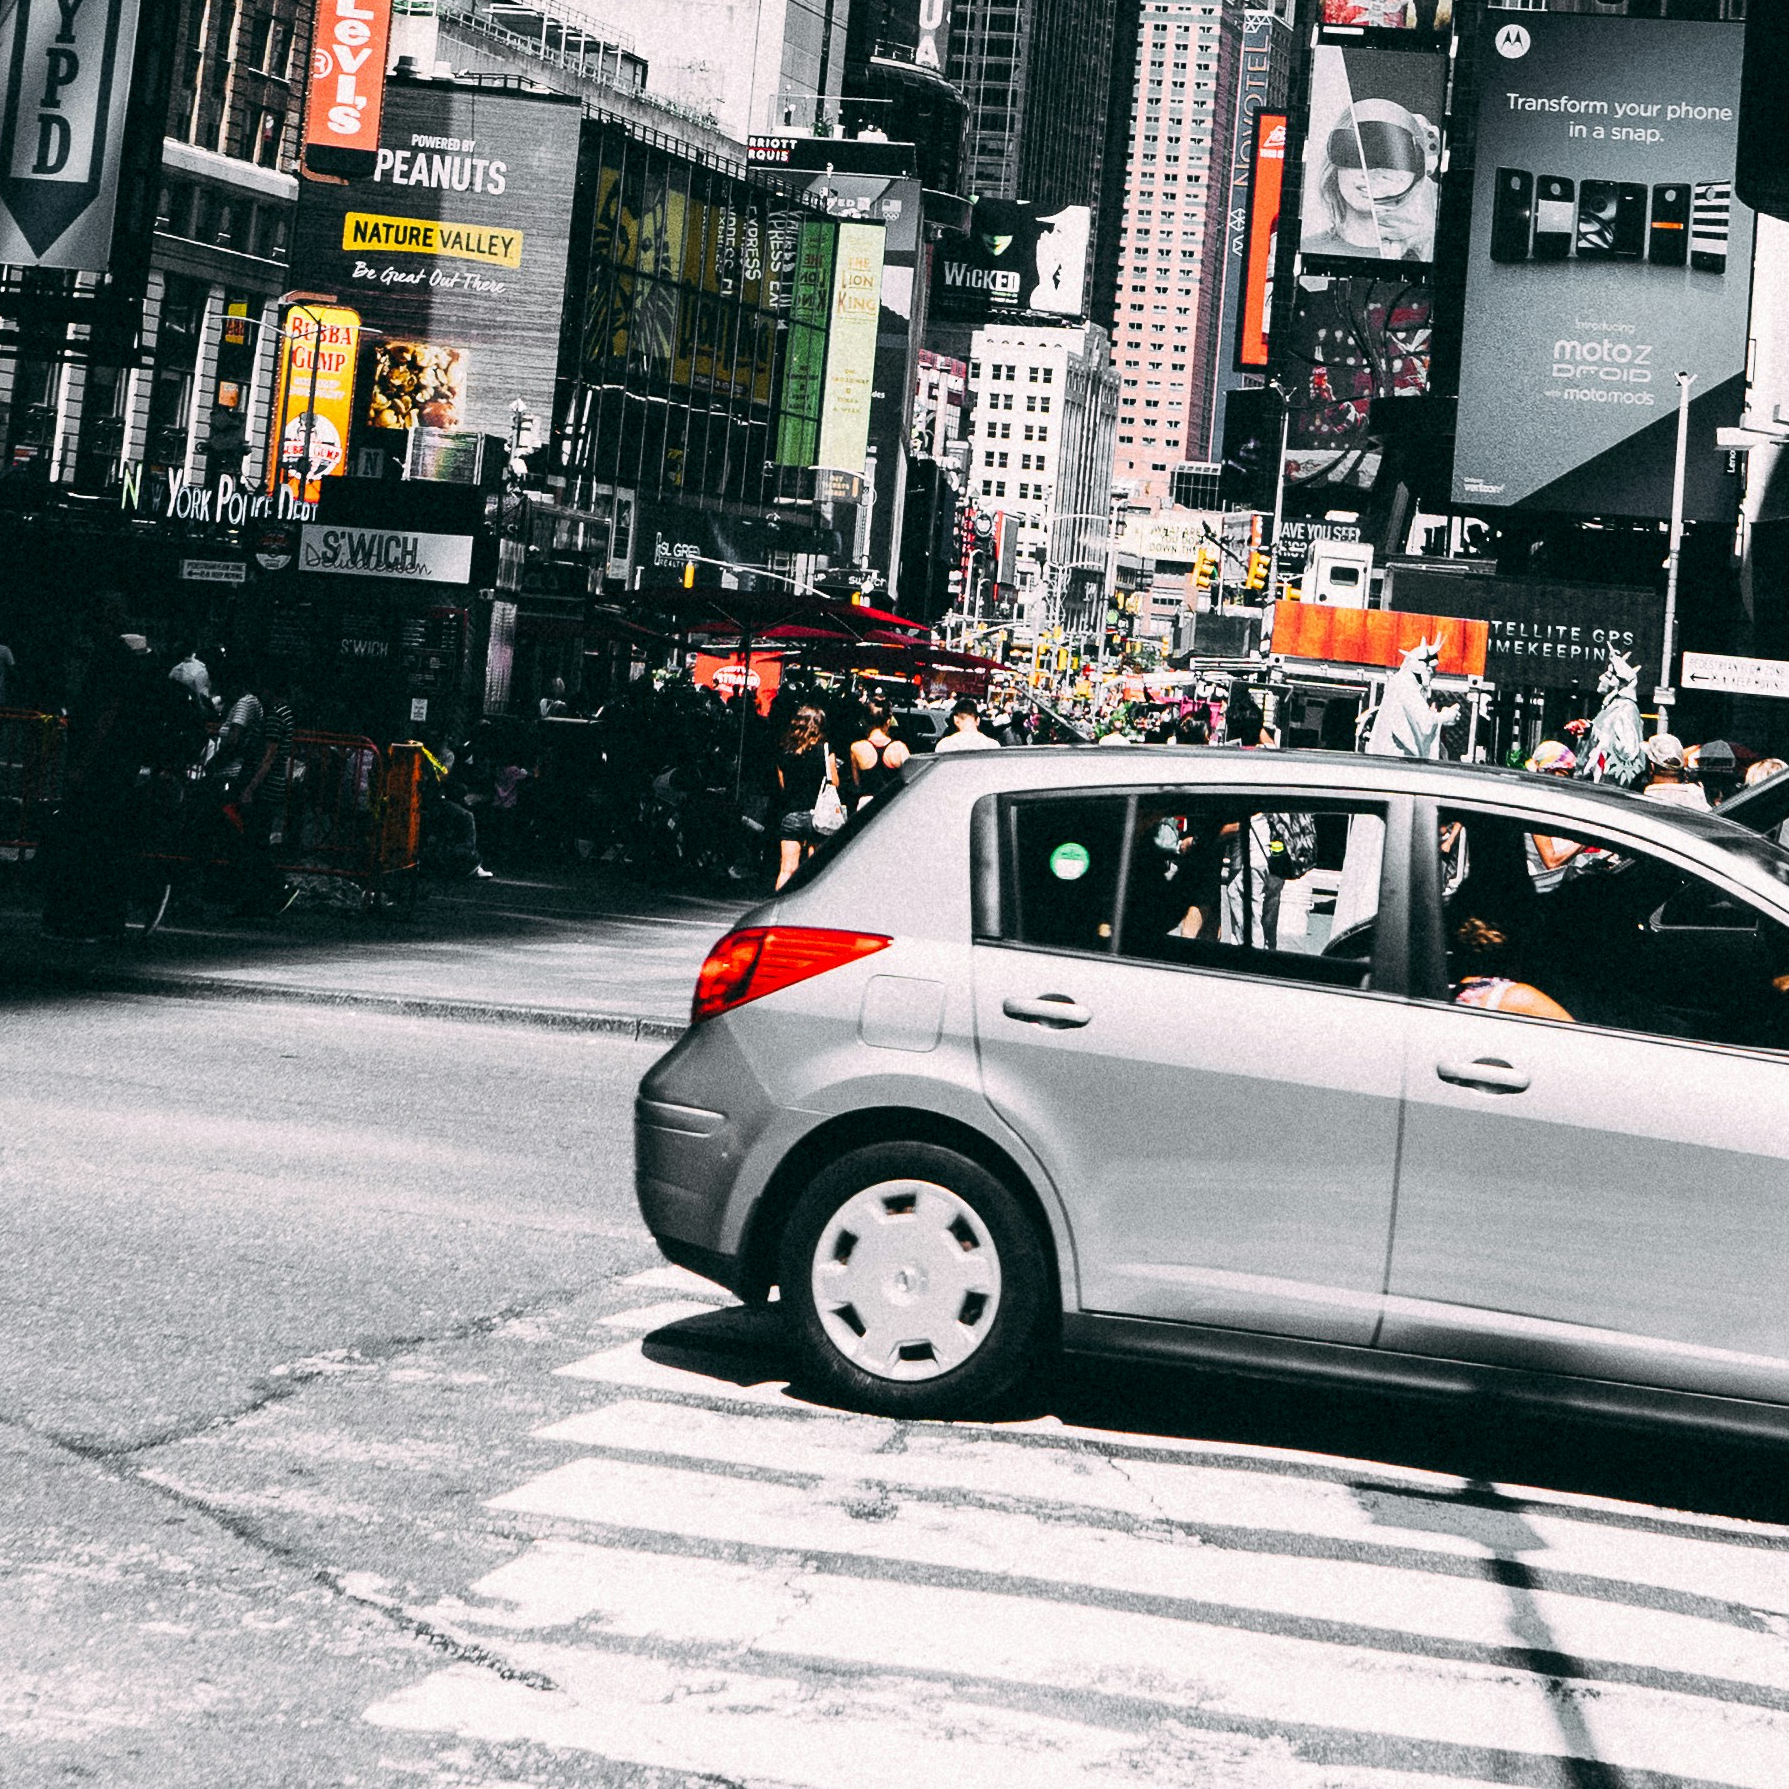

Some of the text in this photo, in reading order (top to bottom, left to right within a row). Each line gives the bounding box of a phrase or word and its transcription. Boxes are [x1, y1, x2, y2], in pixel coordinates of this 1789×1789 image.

[1507, 92, 1732, 122] Transform your phone
[412, 134, 475, 152] POWERED BY
[749, 137, 797, 149] RRIOTT
[1568, 120, 1664, 144] in a snap.
[748, 149, 788, 161] RQUIS
[374, 149, 507, 195] PEANUTS
[353, 220, 514, 258] NATURE VALLEY
[352, 262, 506, 295] Be Great Out There
[842, 268, 874, 289] LION
[837, 290, 876, 316] KING
[292, 317, 352, 346] BUBBA
[1576, 318, 1635, 334] Introducing
[292, 346, 346, 372] GUMP
[1554, 339, 1633, 363] moto
[1552, 363, 1652, 383] DROID
[166, 467, 210, 521] YORK
[1307, 526, 1331, 540] YOU
[322, 531, 418, 570] S'WICH
[1491, 621, 1634, 645] TELLITE GPS
[340, 638, 388, 656] S'WICH
